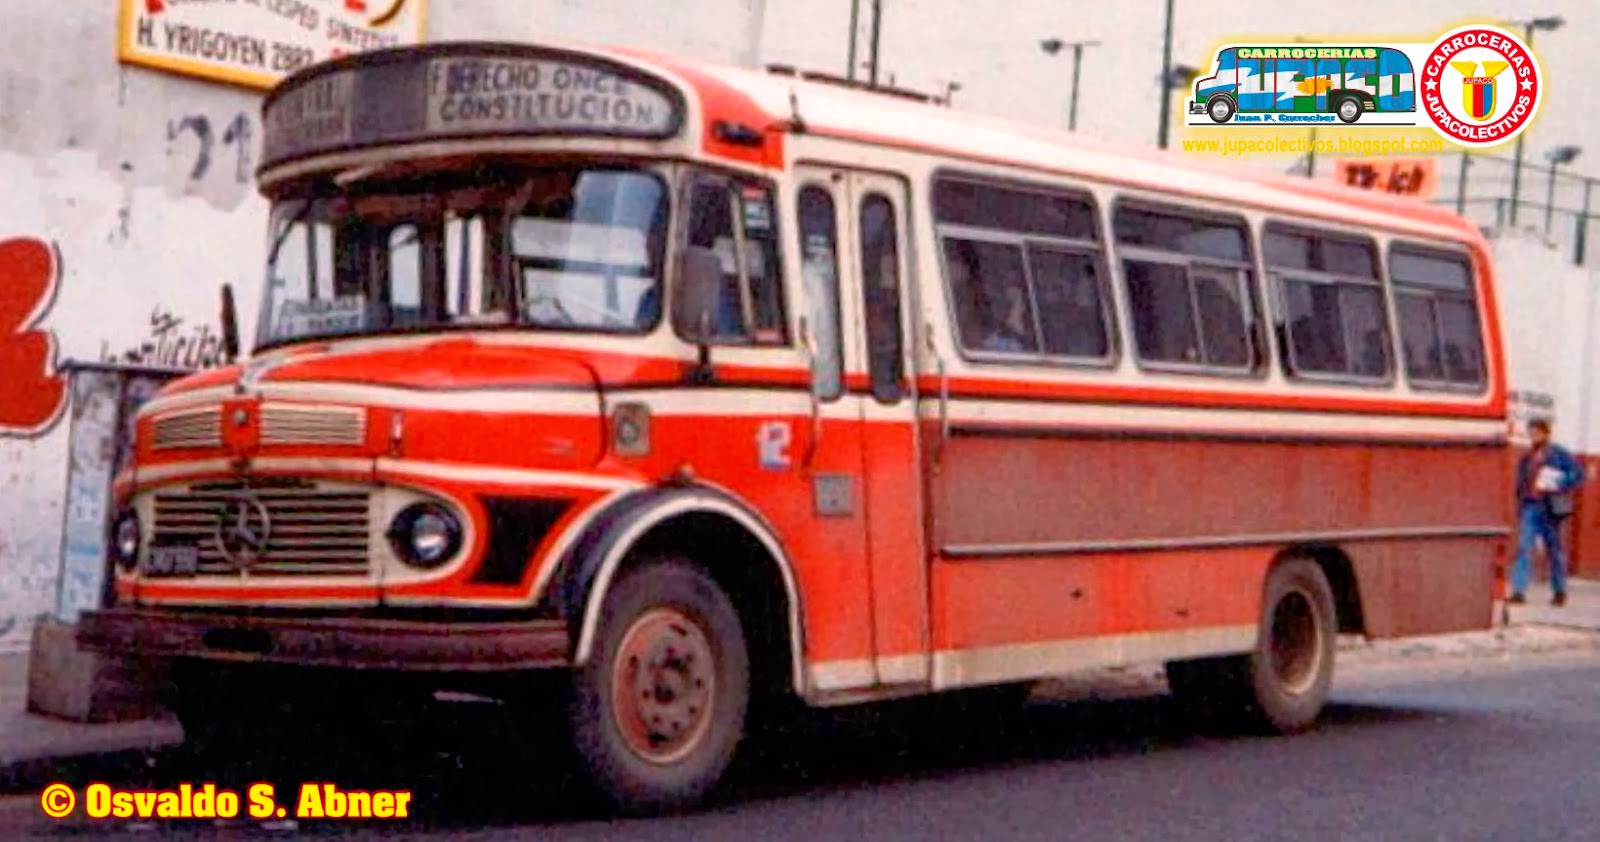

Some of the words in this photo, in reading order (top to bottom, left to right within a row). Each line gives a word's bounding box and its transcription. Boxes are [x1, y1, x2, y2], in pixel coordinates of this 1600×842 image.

[164, 24, 266, 67] YRIGOYEN
[553, 66, 625, 96] ONCE
[439, 95, 654, 124] CONSTITUCION
